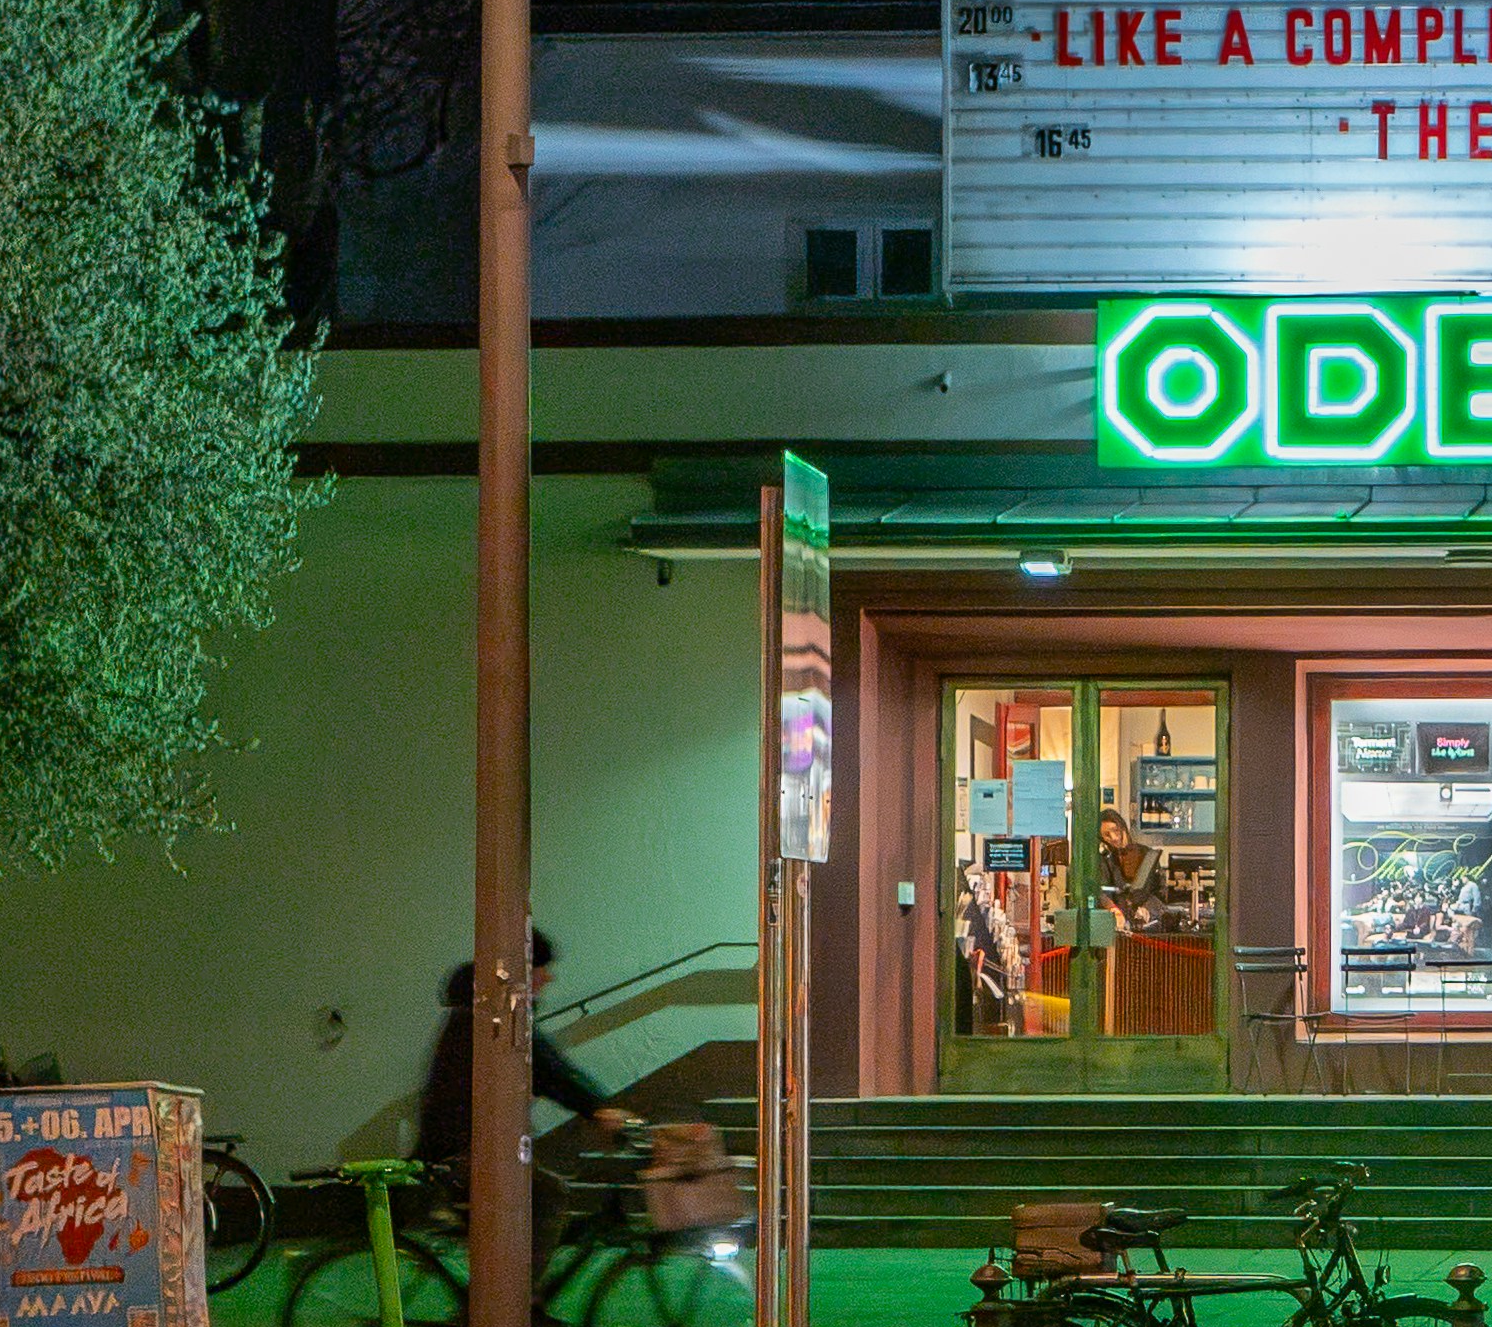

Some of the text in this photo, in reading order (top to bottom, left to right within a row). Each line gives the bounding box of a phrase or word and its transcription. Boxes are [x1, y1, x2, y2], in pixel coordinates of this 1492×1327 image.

[1057, 9, 1182, 67] LIKE
[1218, 9, 1255, 65] A
[3, 1153, 121, 1199] Taste of
[10, 1189, 130, 1250] Africa
